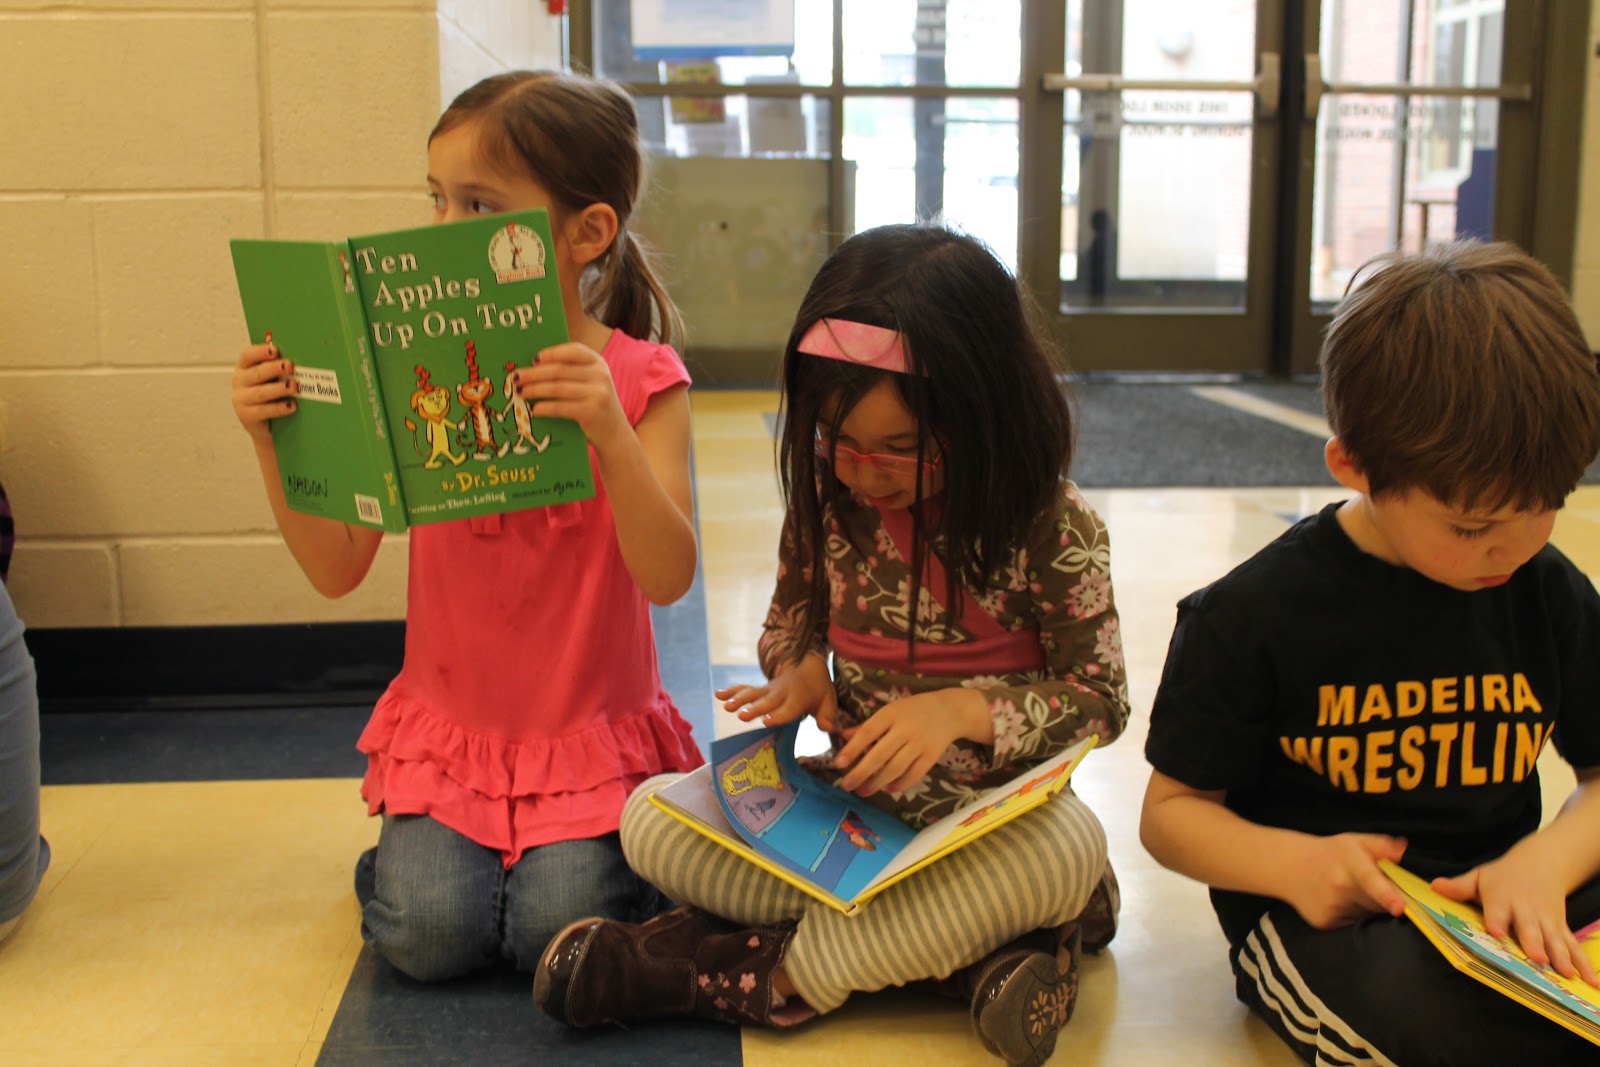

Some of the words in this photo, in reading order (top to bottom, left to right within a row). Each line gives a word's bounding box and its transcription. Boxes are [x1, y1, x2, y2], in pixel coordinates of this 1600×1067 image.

[355, 246, 418, 275] Ten
[373, 275, 481, 313] Apples
[371, 320, 414, 350] Up
[422, 311, 469, 338] On
[476, 293, 543, 330] Top!
[316, 382, 339, 398] Books
[456, 471, 486, 493] Dr.
[1316, 672, 1543, 727] MADEIRA
[1279, 720, 1555, 794] WRESTLIN
